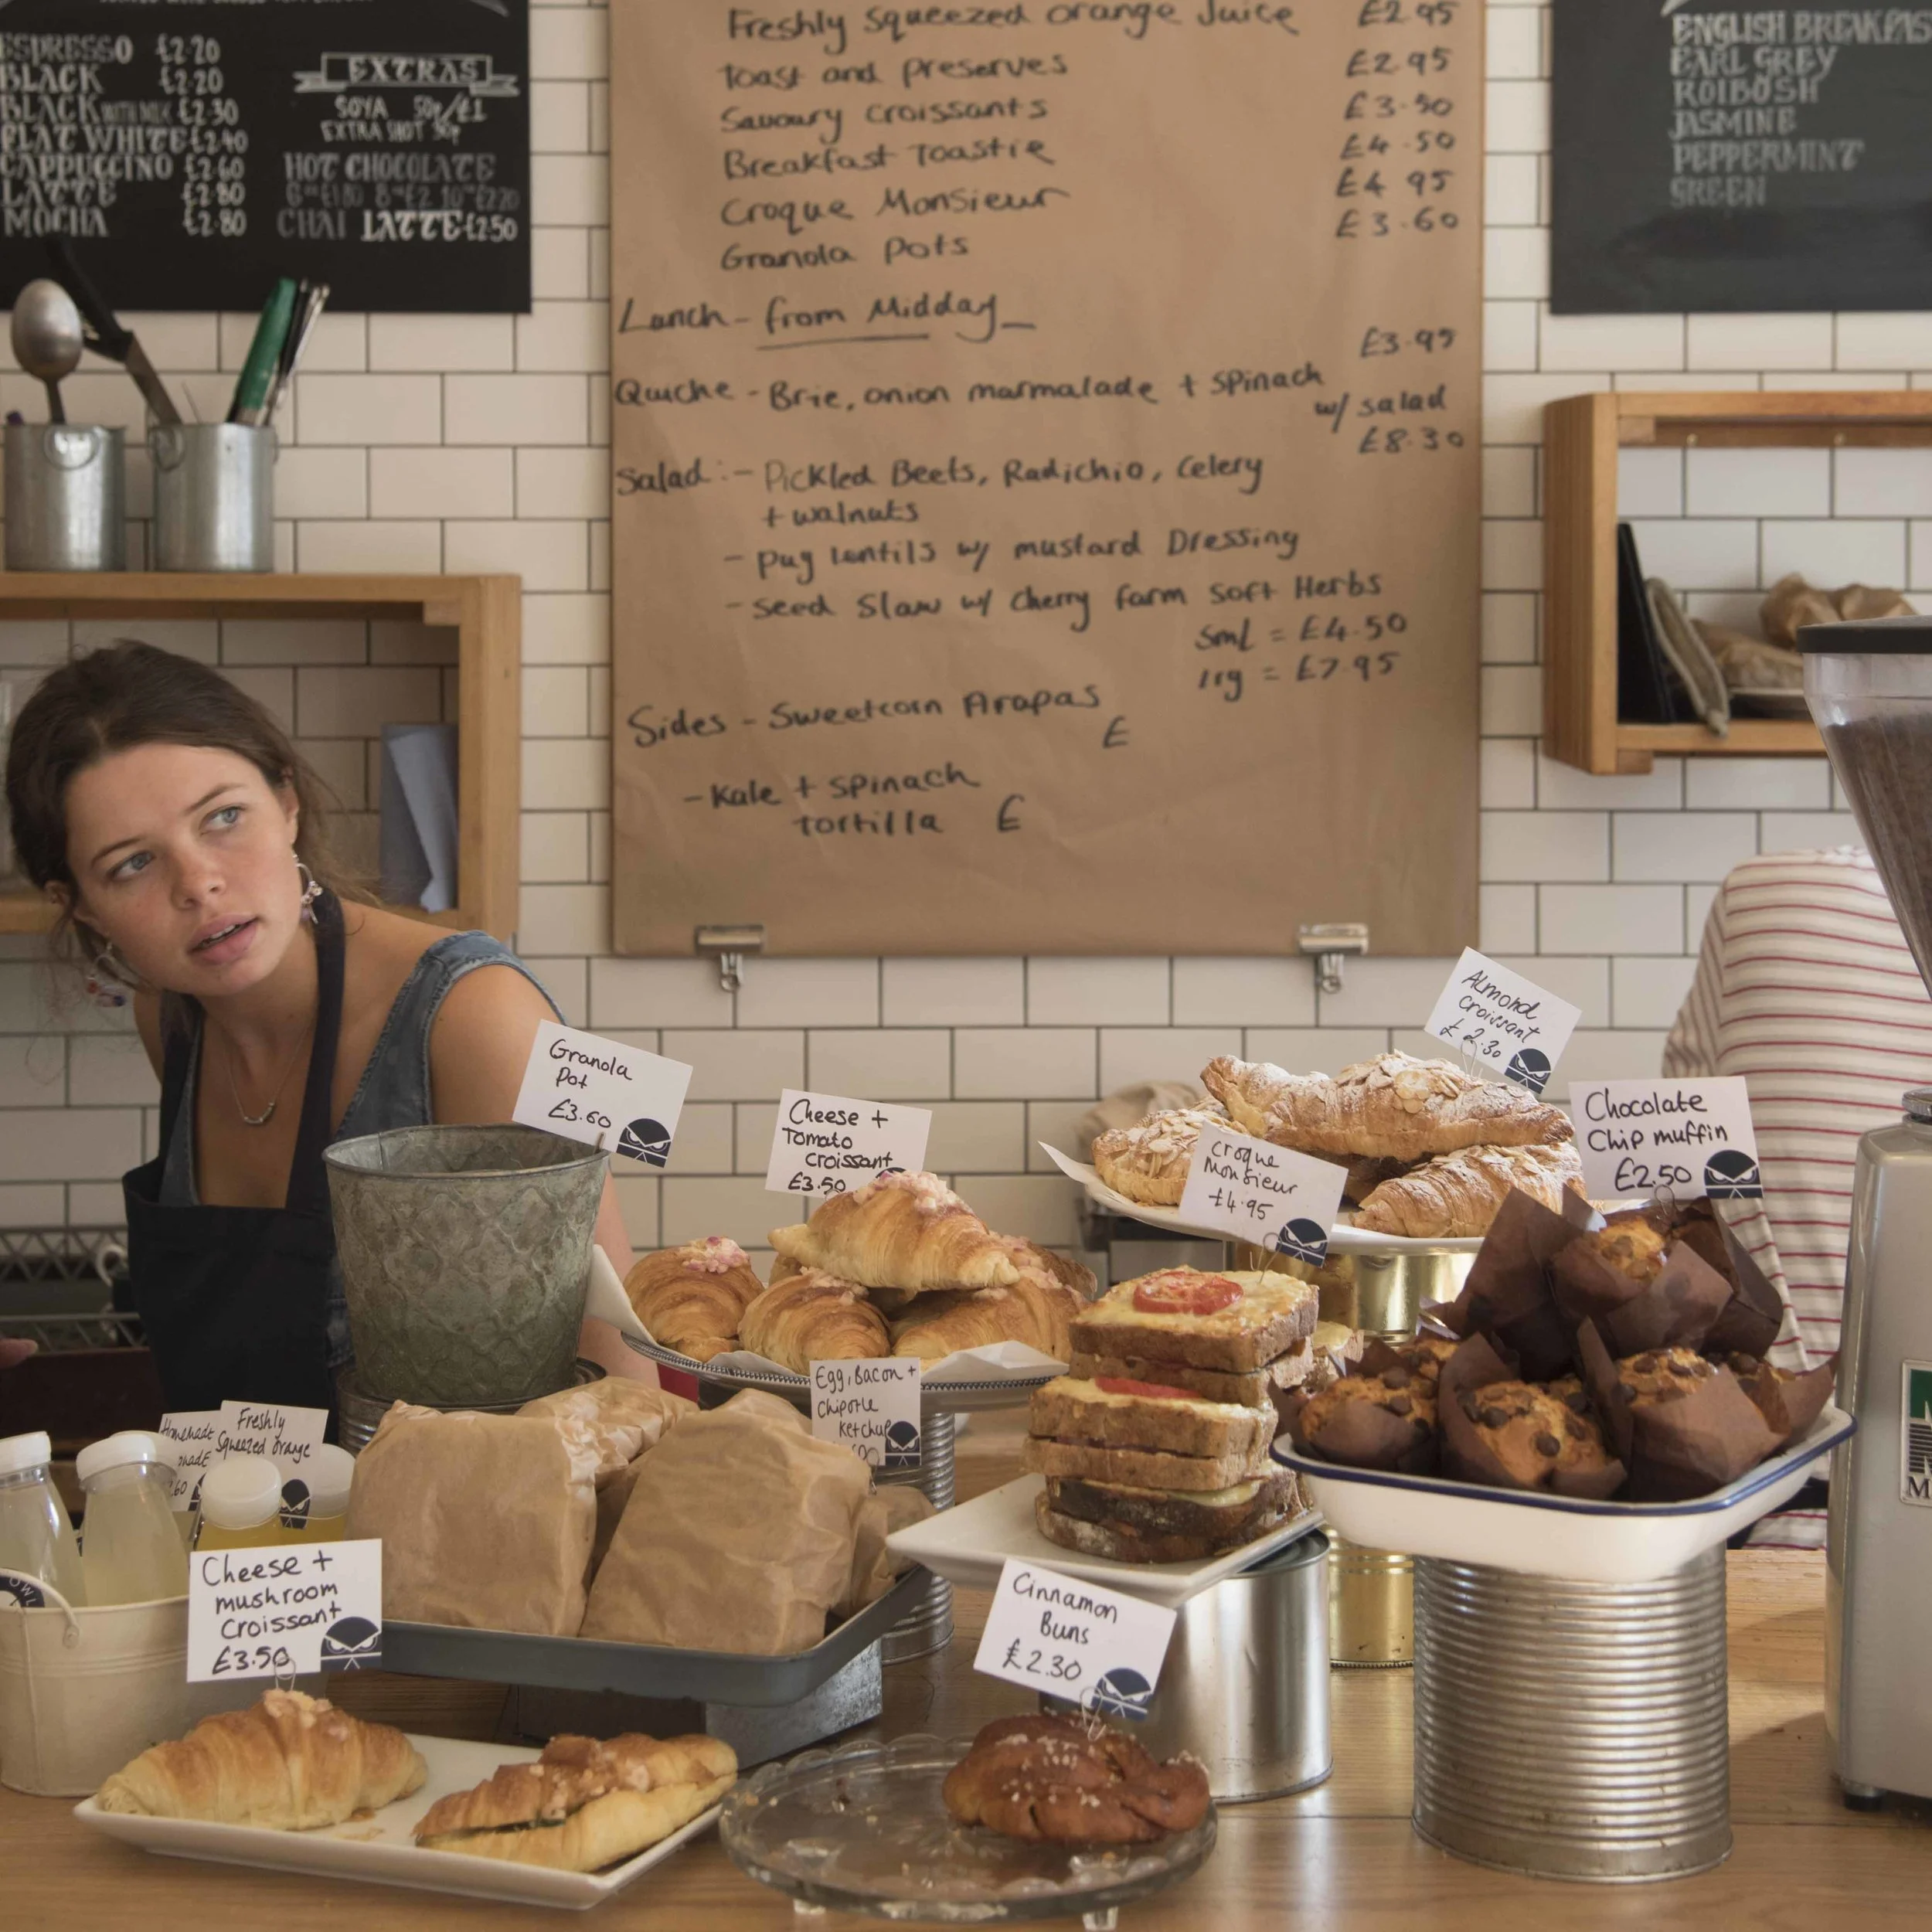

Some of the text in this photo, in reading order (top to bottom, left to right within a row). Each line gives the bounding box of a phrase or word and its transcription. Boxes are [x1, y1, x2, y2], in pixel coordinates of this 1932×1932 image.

[728, 9, 846, 56] Freshly
[1197, 0, 1300, 36] Juice
[1672, 11, 1787, 49] ENGLISH
[349, 56, 479, 83] EXTRAS
[821, 61, 882, 84] and
[1670, 45, 1838, 80] EARL GREY
[0, 63, 104, 94] BLACK
[0, 94, 101, 124] BLACK
[335, 94, 388, 119] SOYA
[2, 122, 77, 152] FLAT
[83, 125, 187, 154] WHITE
[320, 120, 383, 142] EXTRA
[720, 106, 843, 145] Savoury
[1668, 106, 1797, 140] JASMINE
[0, 151, 173, 181] CAPPUCCINO
[284, 151, 497, 182] HOT CHOCOLATE
[724, 145, 896, 181] Breakfast
[907, 138, 1056, 167] Toastie
[1672, 139, 1866, 174] PEPPERMINT
[2, 179, 117, 209] LATTE
[3, 206, 109, 236] MOCHA
[277, 208, 347, 240] CHAI
[361, 209, 463, 242] LATTE
[720, 198, 854, 236] Croque
[876, 188, 1070, 217] Monsieur
[720, 243, 857, 271] Granola
[764, 296, 845, 335] from
[867, 291, 997, 344] Midday
[613, 377, 736, 406] Quiche
[863, 383, 951, 406] onion
[968, 376, 1159, 404] marmalade
[764, 460, 876, 493] Pickled
[890, 456, 989, 488] Beets,
[791, 499, 920, 527] walnuts
[830, 540, 937, 566] lentils
[1014, 530, 1142, 560] mustard
[1167, 528, 1300, 560] Dressing
[1294, 570, 1383, 600] Herbs
[627, 685, 1101, 749] Sides Sweetcorn Arapas
[793, 811, 944, 836] tortilla
[549, 1039, 633, 1080] Granola
[548, 1098, 611, 1128] £3.60
[789, 1098, 889, 1128] Cheese +
[1585, 1087, 1708, 1121] Chocolate
[782, 1128, 853, 1149] Tomato
[1587, 1120, 1728, 1151] Chip muffin
[787, 1172, 846, 1196] £3.50
[1204, 1156, 1298, 1194] Monsieur
[1614, 1157, 1692, 1192] £2.50
[1209, 1187, 1274, 1220] £4.95
[855, 1365, 903, 1386] Bacon
[237, 1407, 286, 1440] Freshly
[215, 1430, 267, 1461] Squeezed
[202, 1549, 333, 1586] Cheese +
[216, 1583, 338, 1614] mushroom
[1013, 1572, 1117, 1624] Cinnamon
[1040, 1611, 1090, 1645] Buns
[212, 1645, 290, 1675] £3.50
[1002, 1638, 1082, 1681] £2.30
